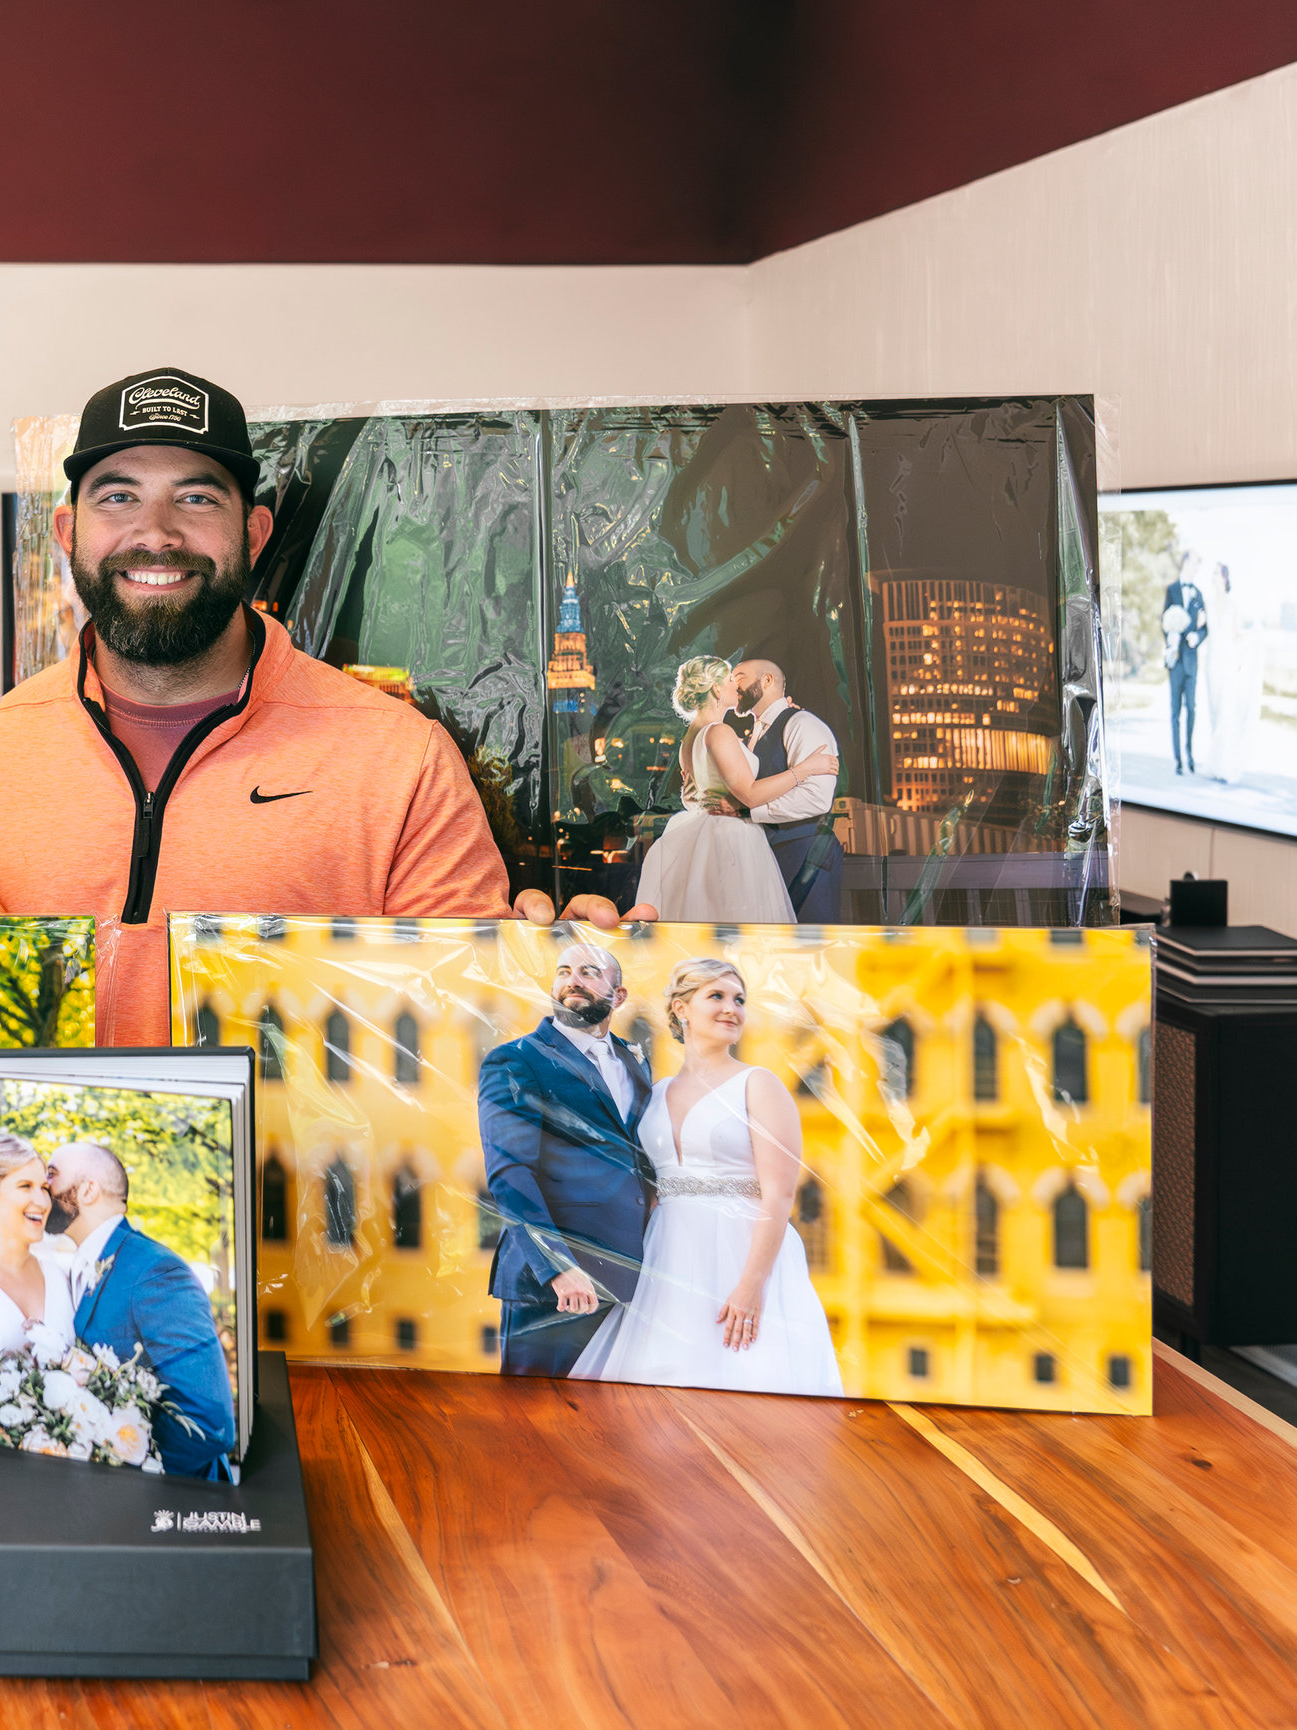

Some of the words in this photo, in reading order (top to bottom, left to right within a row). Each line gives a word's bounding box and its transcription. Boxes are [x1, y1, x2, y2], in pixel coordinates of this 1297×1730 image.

[128, 387, 201, 405] Cleveland
[142, 406, 162, 414] BUILT
[173, 407, 188, 417] LAST
[183, 1511, 246, 1521] JUSTIN
[183, 1519, 261, 1532] GAMBLE
